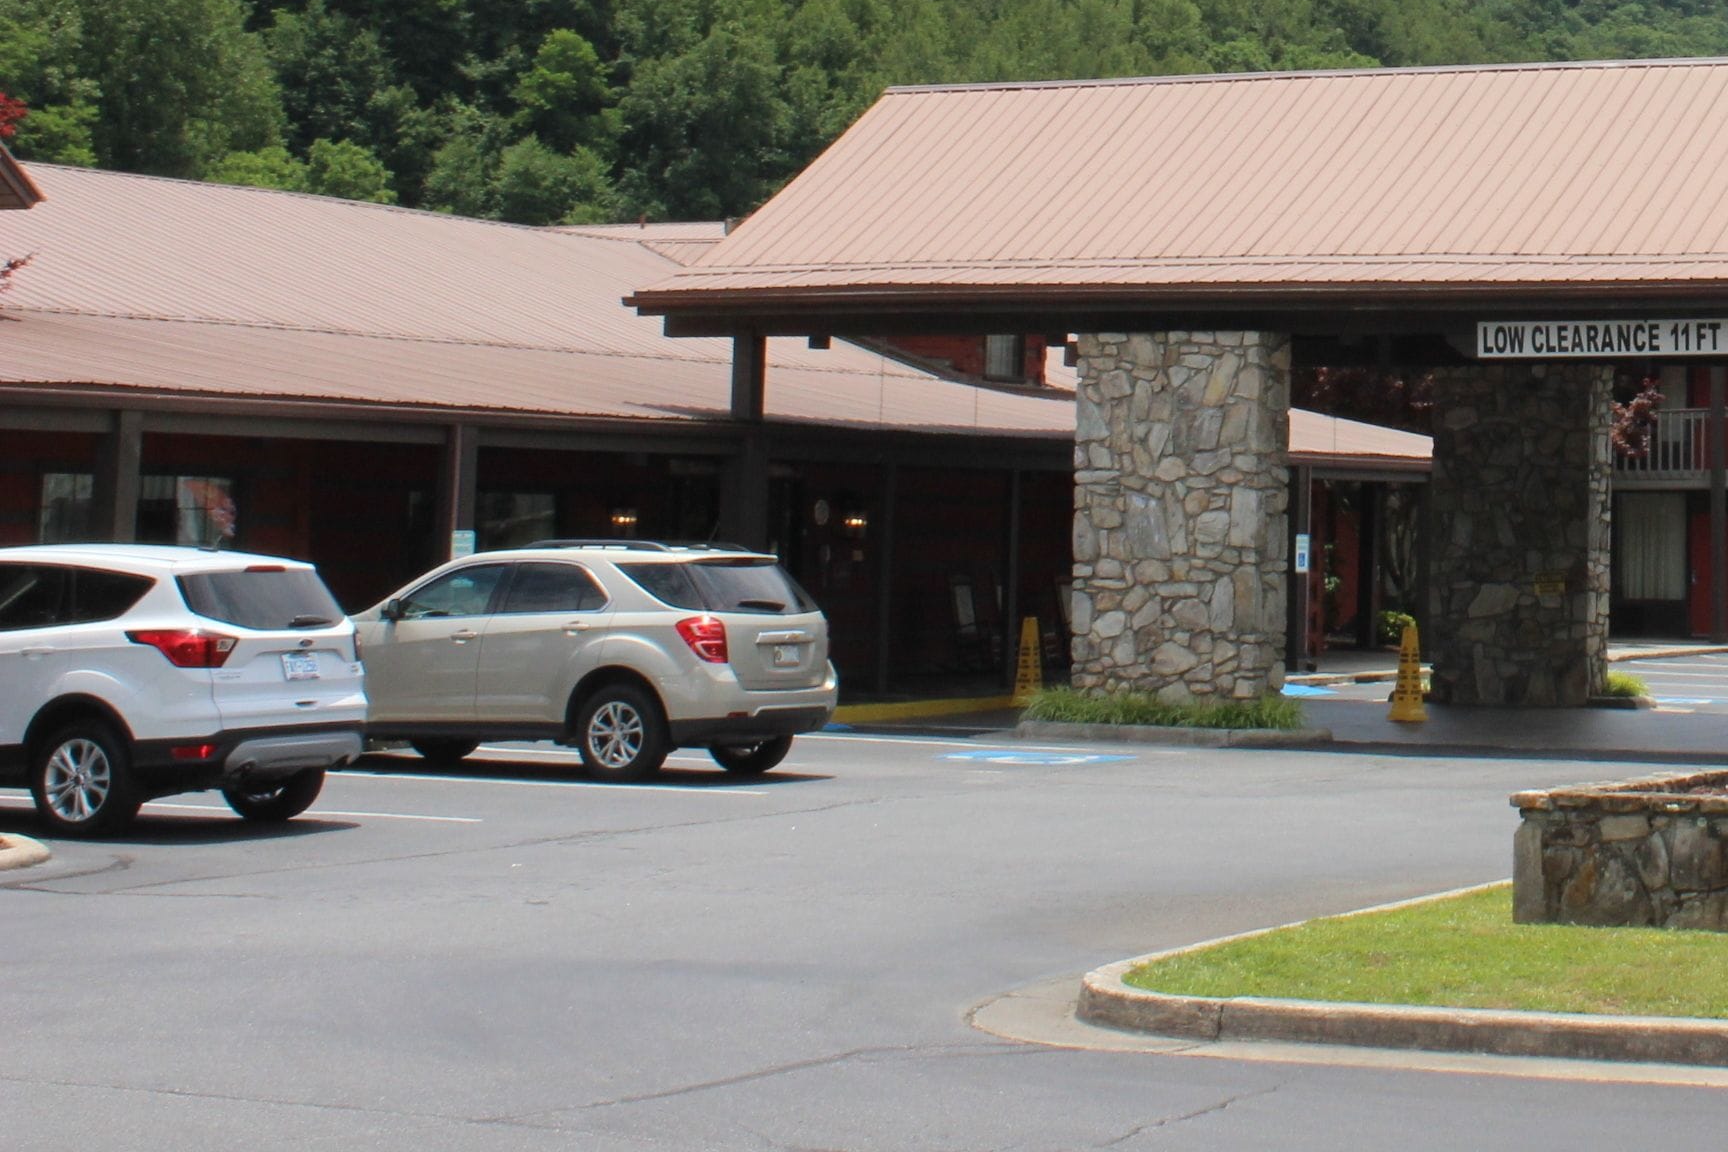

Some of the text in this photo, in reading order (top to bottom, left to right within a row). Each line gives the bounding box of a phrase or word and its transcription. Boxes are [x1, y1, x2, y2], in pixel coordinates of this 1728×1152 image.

[1482, 322, 1721, 354] LOW CLEARANCE 11 FT
